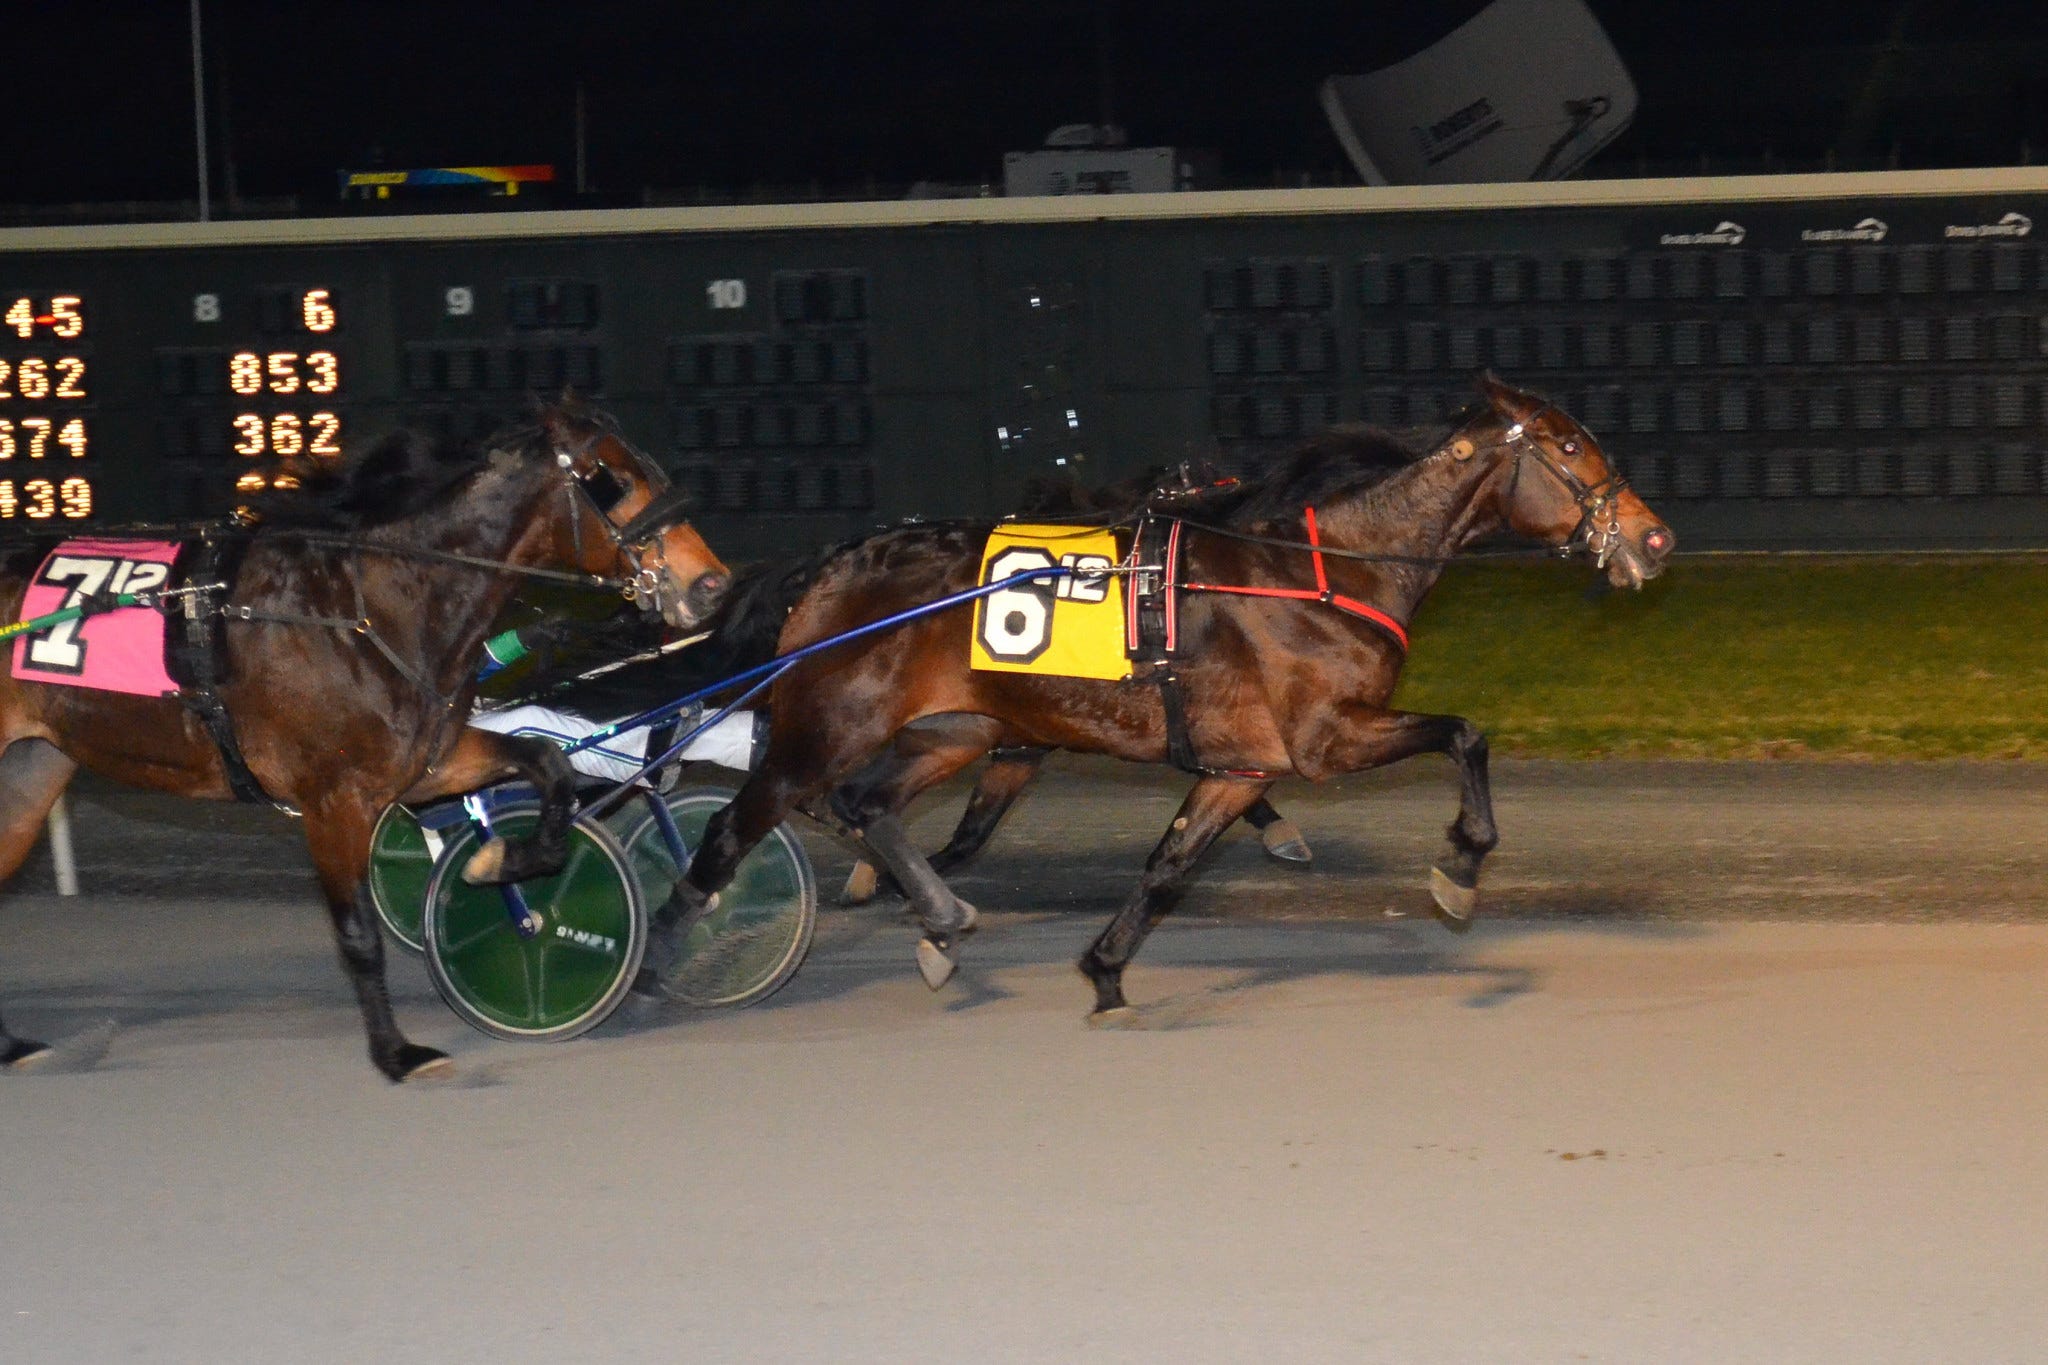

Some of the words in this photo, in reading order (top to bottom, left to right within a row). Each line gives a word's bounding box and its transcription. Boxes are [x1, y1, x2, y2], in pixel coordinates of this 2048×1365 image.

[194, 294, 220, 321] 8
[303, 289, 335, 332] 6
[445, 287, 474, 315] 9
[706, 279, 746, 309] 10
[5, 297, 84, 338] 4-5
[230, 352, 338, 394] 853
[233, 412, 341, 455] 362
[1056, 554, 1110, 603] 12
[28, 555, 117, 670] 7
[981, 549, 1054, 659] 6
